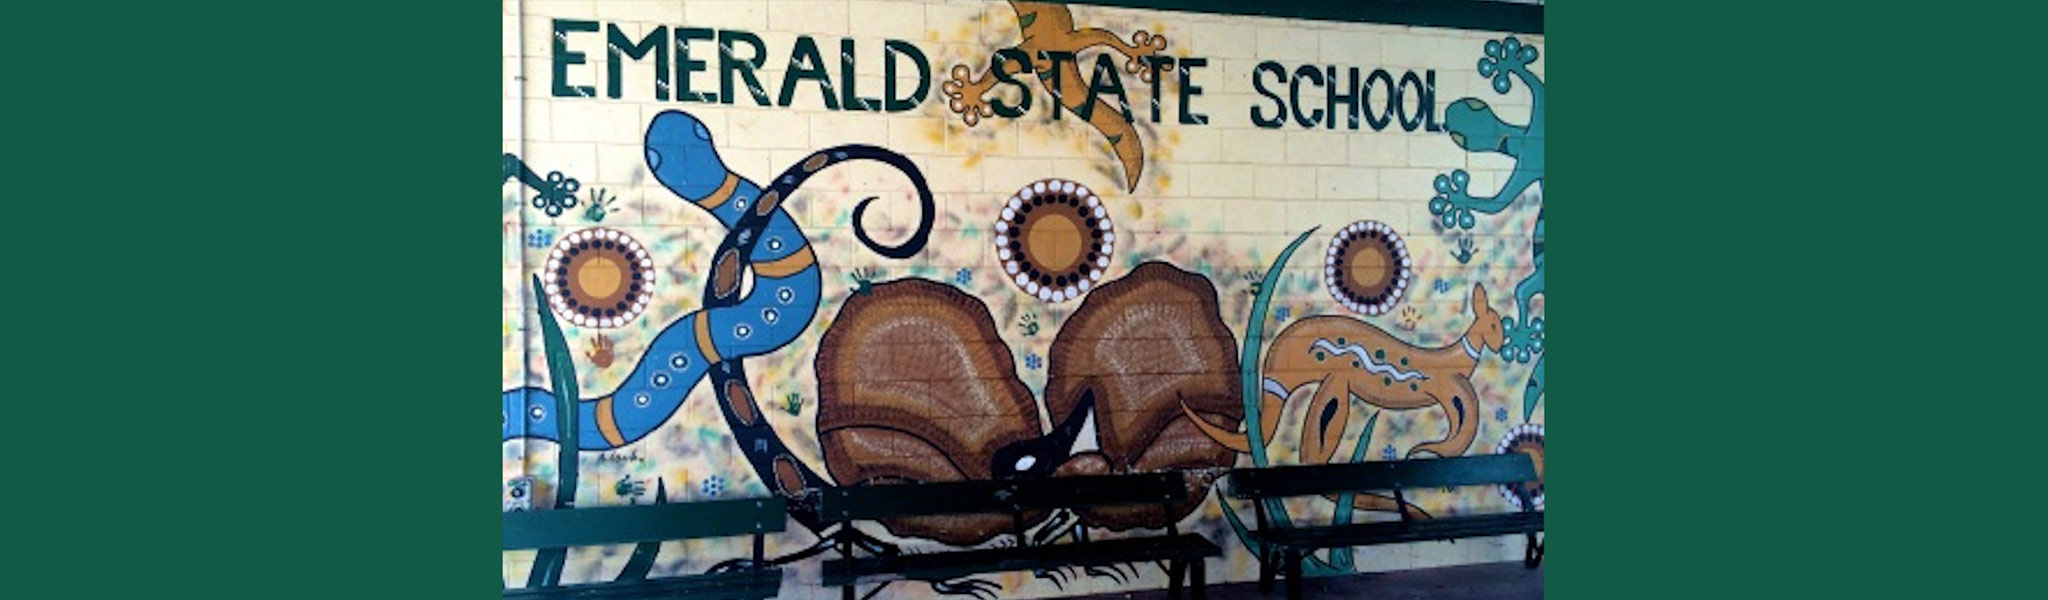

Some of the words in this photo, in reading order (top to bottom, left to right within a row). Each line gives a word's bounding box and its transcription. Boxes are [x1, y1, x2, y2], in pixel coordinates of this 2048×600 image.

[552, 18, 931, 112] EMERALD
[990, 48, 1209, 125] STATE
[1250, 60, 1449, 132] SCHOOL
